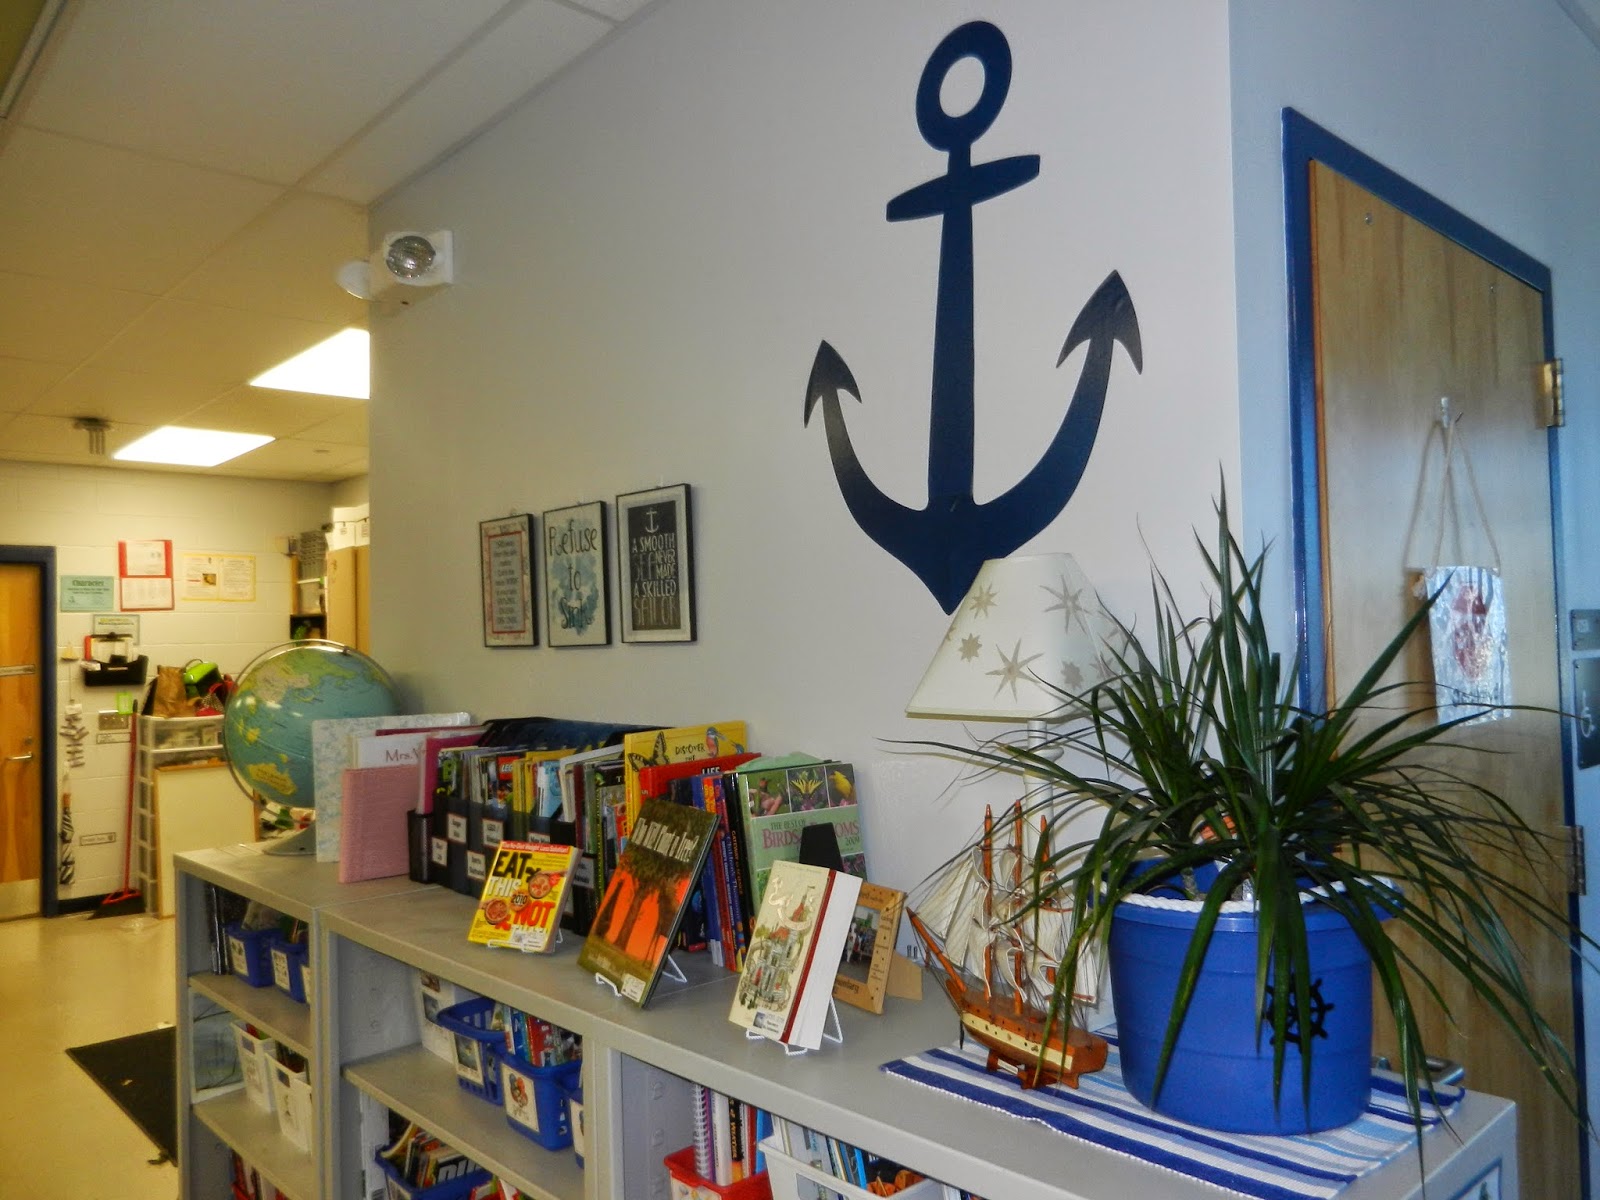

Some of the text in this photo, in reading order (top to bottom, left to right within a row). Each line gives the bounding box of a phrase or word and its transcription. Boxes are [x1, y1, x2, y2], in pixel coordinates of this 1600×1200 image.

[549, 519, 598, 556] Refuse
[632, 532, 676, 553] A SMOOTH
[632, 551, 656, 582] SEA
[655, 550, 676, 564] NEVER
[568, 562, 581, 591] to
[655, 563, 677, 580] MADE
[633, 579, 677, 598] A SKILLED
[633, 597, 678, 626] SAILOR
[385, 748, 413, 762] Mrs.
[675, 743, 706, 755] DISCOVER
[771, 822, 782, 831] THE
[783, 820, 798, 830] BEST
[630, 817, 649, 846] Who
[642, 820, 662, 850] Will
[653, 824, 677, 857] Plant
[762, 828, 800, 849] BIRDS
[491, 850, 533, 880] EAT
[511, 893, 528, 908] 2010
[513, 900, 556, 928] NOT
